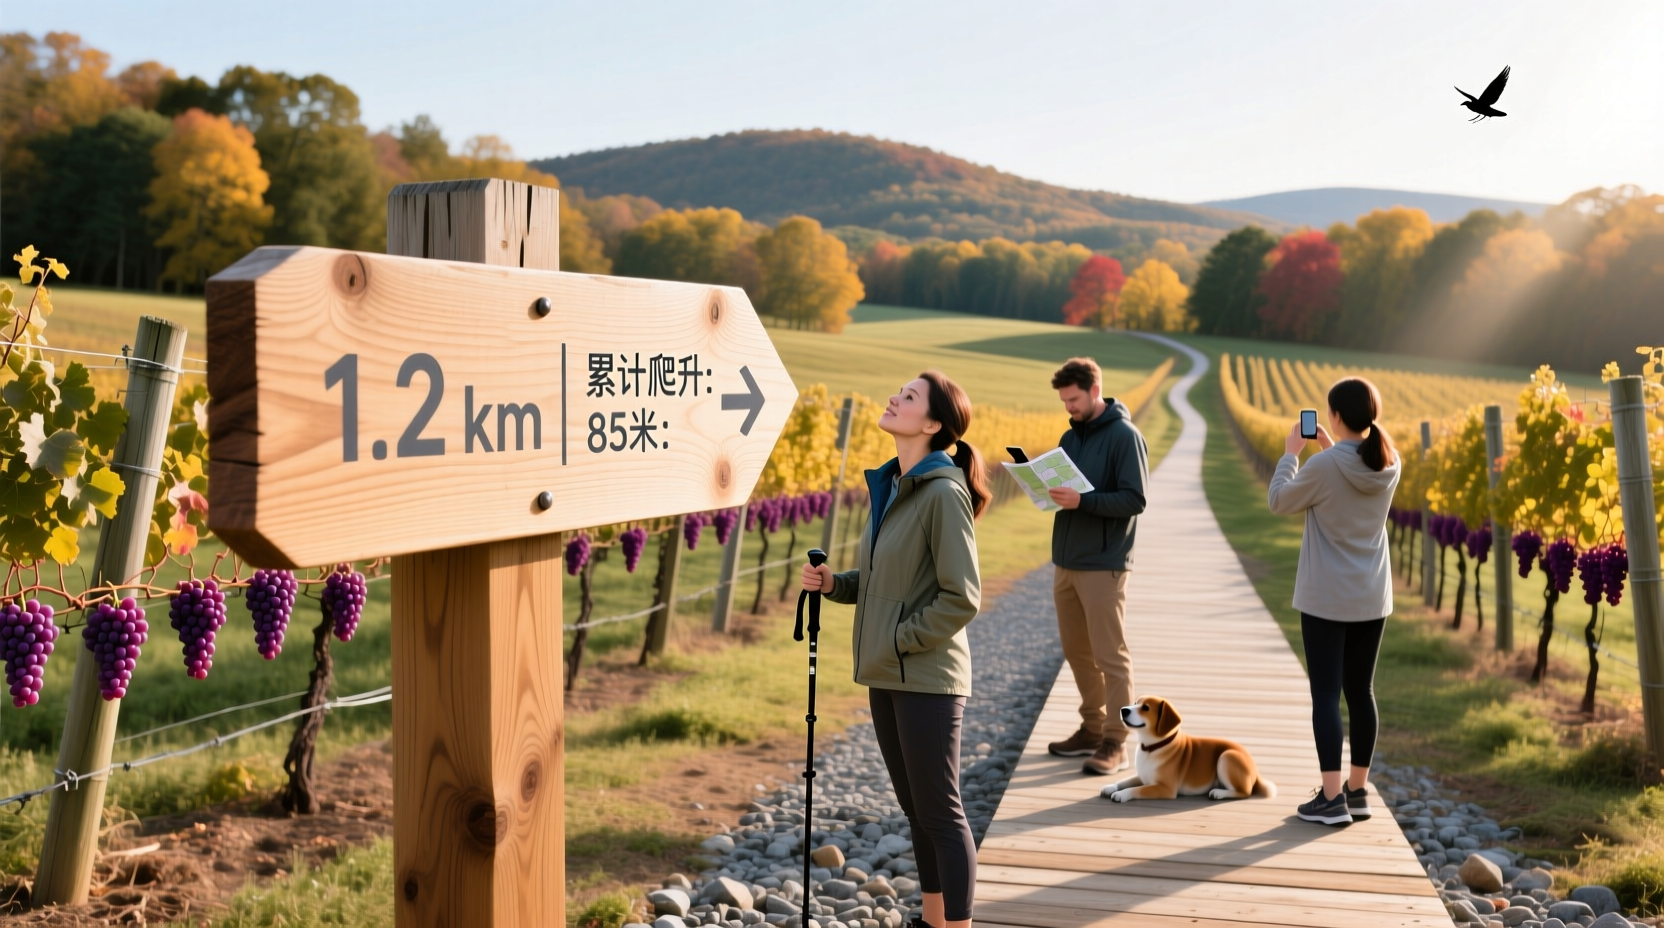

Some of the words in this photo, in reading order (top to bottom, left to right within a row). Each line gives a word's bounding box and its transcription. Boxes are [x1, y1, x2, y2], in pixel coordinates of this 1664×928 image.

[586, 352, 713, 398] 累计爬升:
[324, 352, 446, 463] 1.2
[464, 385, 543, 454] km
[587, 407, 669, 454] 85米:
